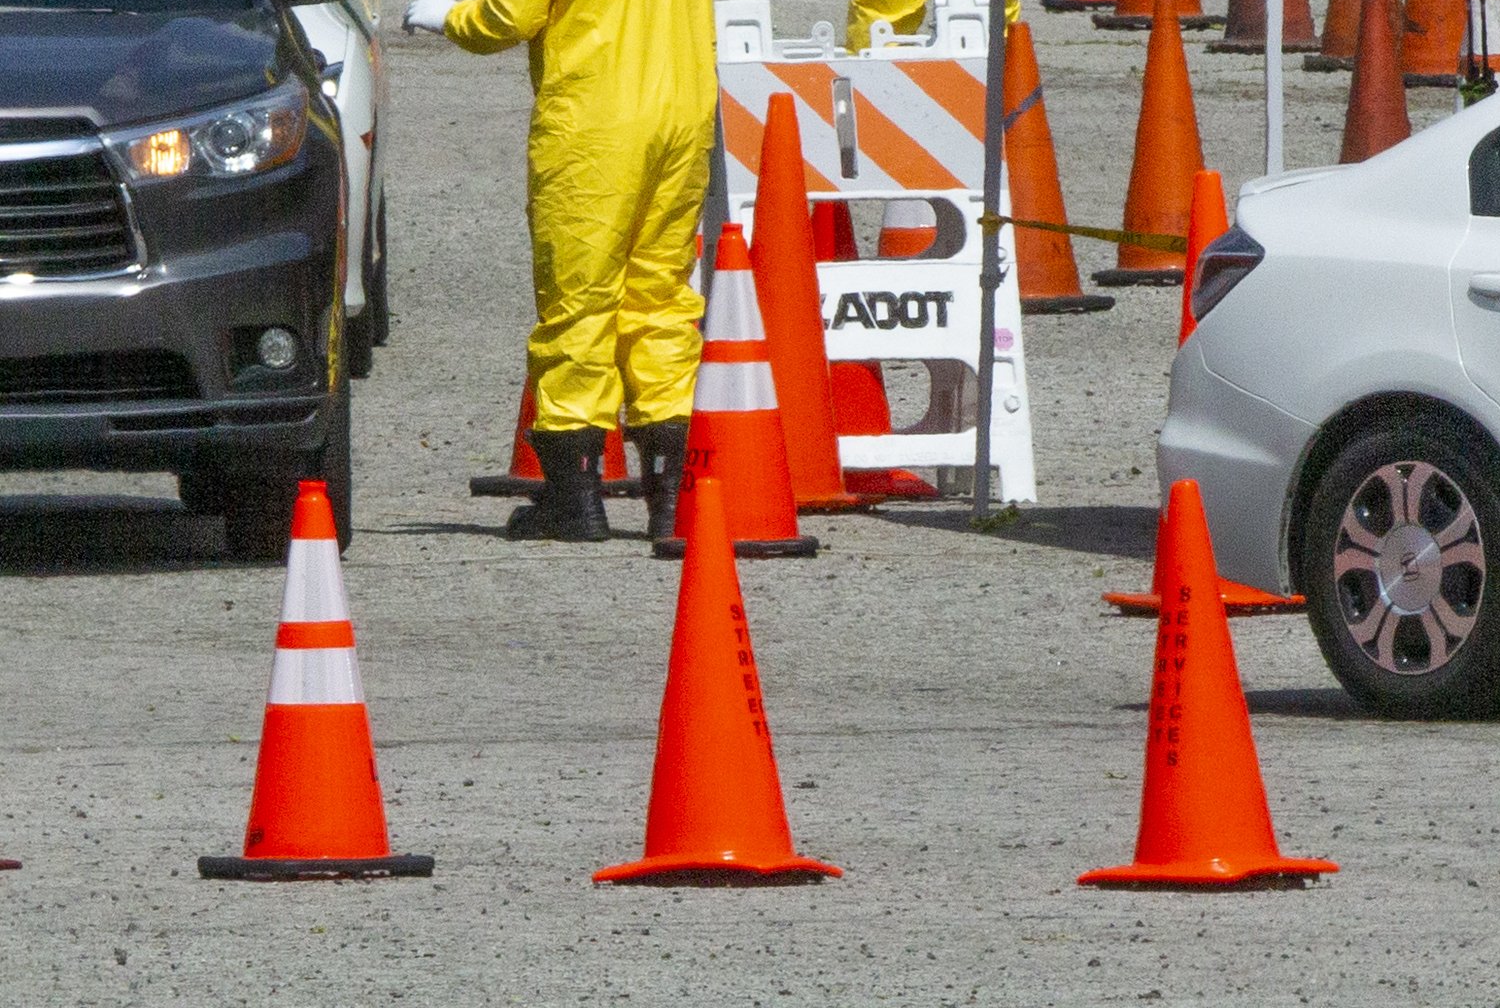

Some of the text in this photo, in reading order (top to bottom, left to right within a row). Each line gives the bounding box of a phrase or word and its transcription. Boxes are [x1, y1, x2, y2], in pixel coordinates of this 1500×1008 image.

[730, 603, 761, 737] STREET
[1155, 610, 1171, 742] STREET
[1167, 585, 1191, 767] SERVICES
